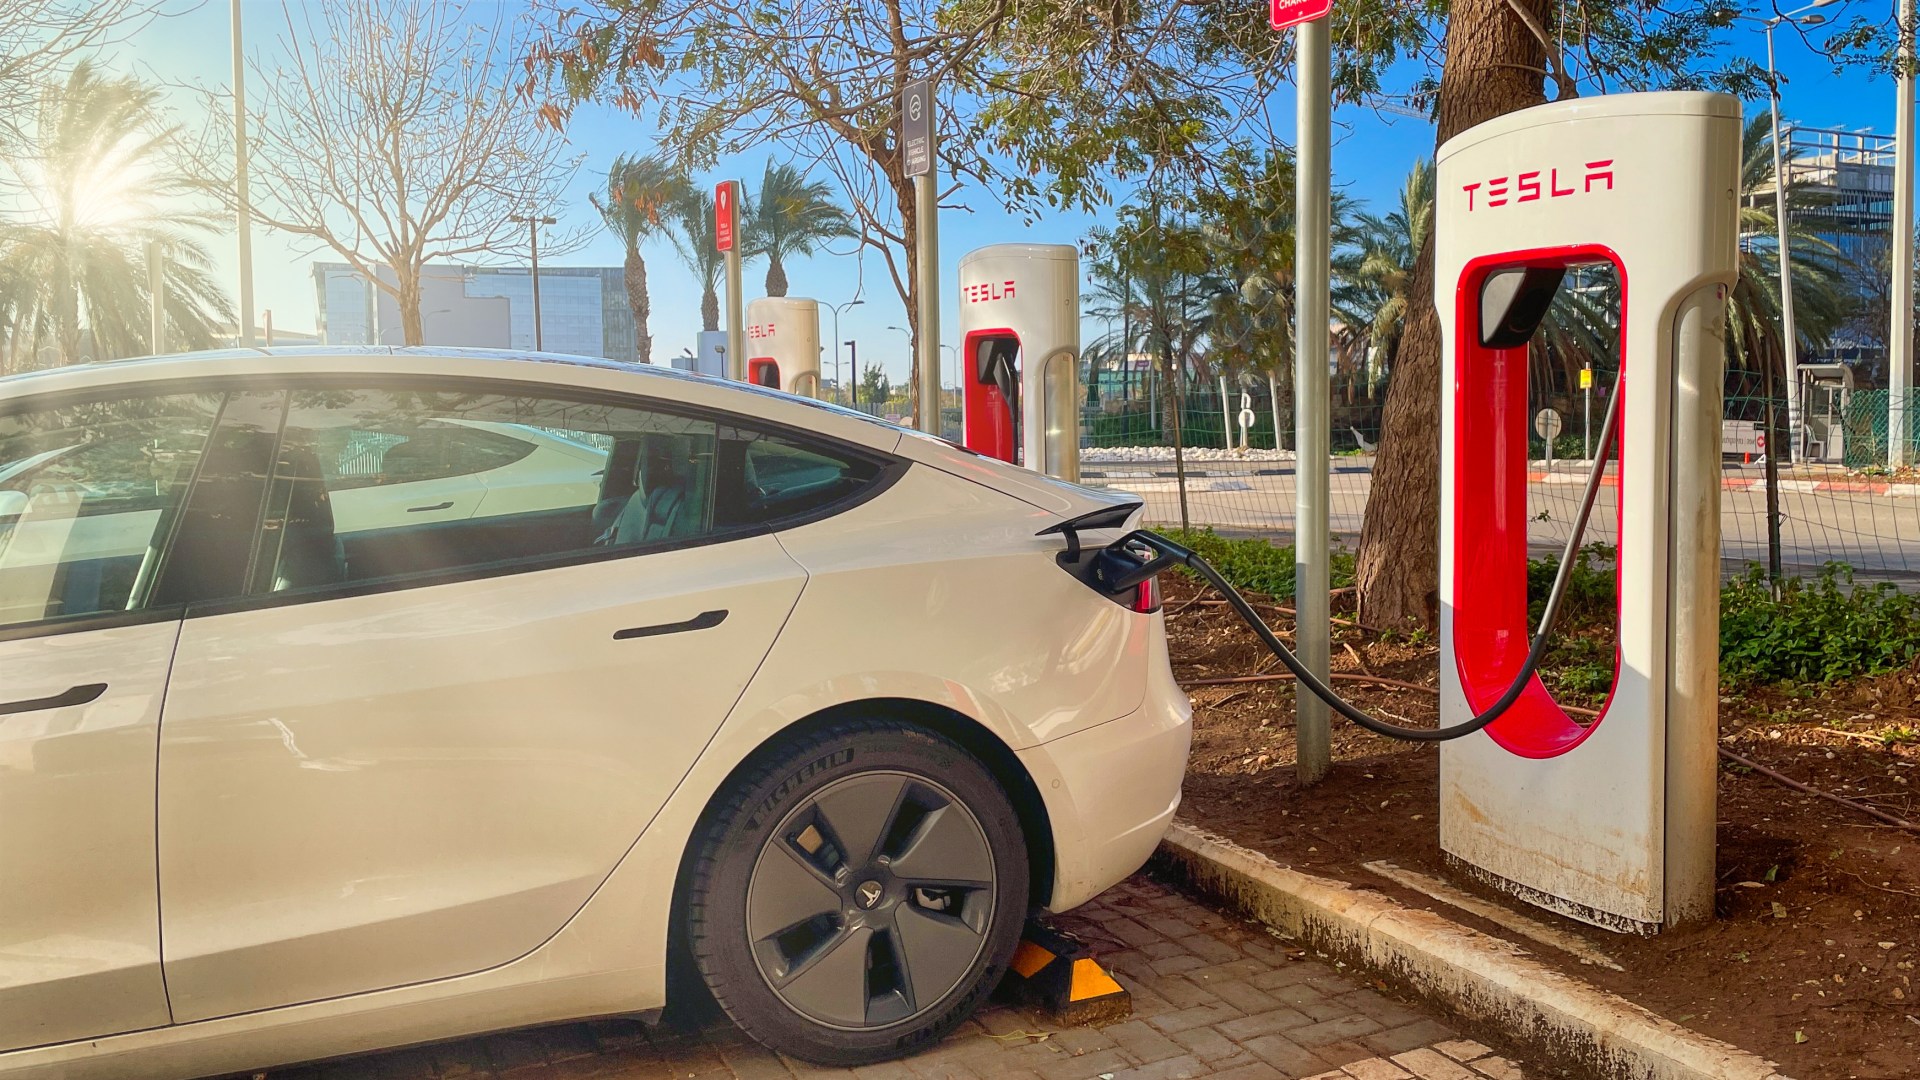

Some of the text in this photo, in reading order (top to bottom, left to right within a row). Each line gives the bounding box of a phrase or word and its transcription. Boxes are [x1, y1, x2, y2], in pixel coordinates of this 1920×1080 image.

[1279, 0, 1308, 9] CHA
[907, 155, 926, 166] CARGING
[1462, 159, 1614, 212] TESLA
[963, 280, 1015, 304] TESLA
[748, 324, 775, 338] ESLA
[745, 748, 854, 830] MICHELIN
